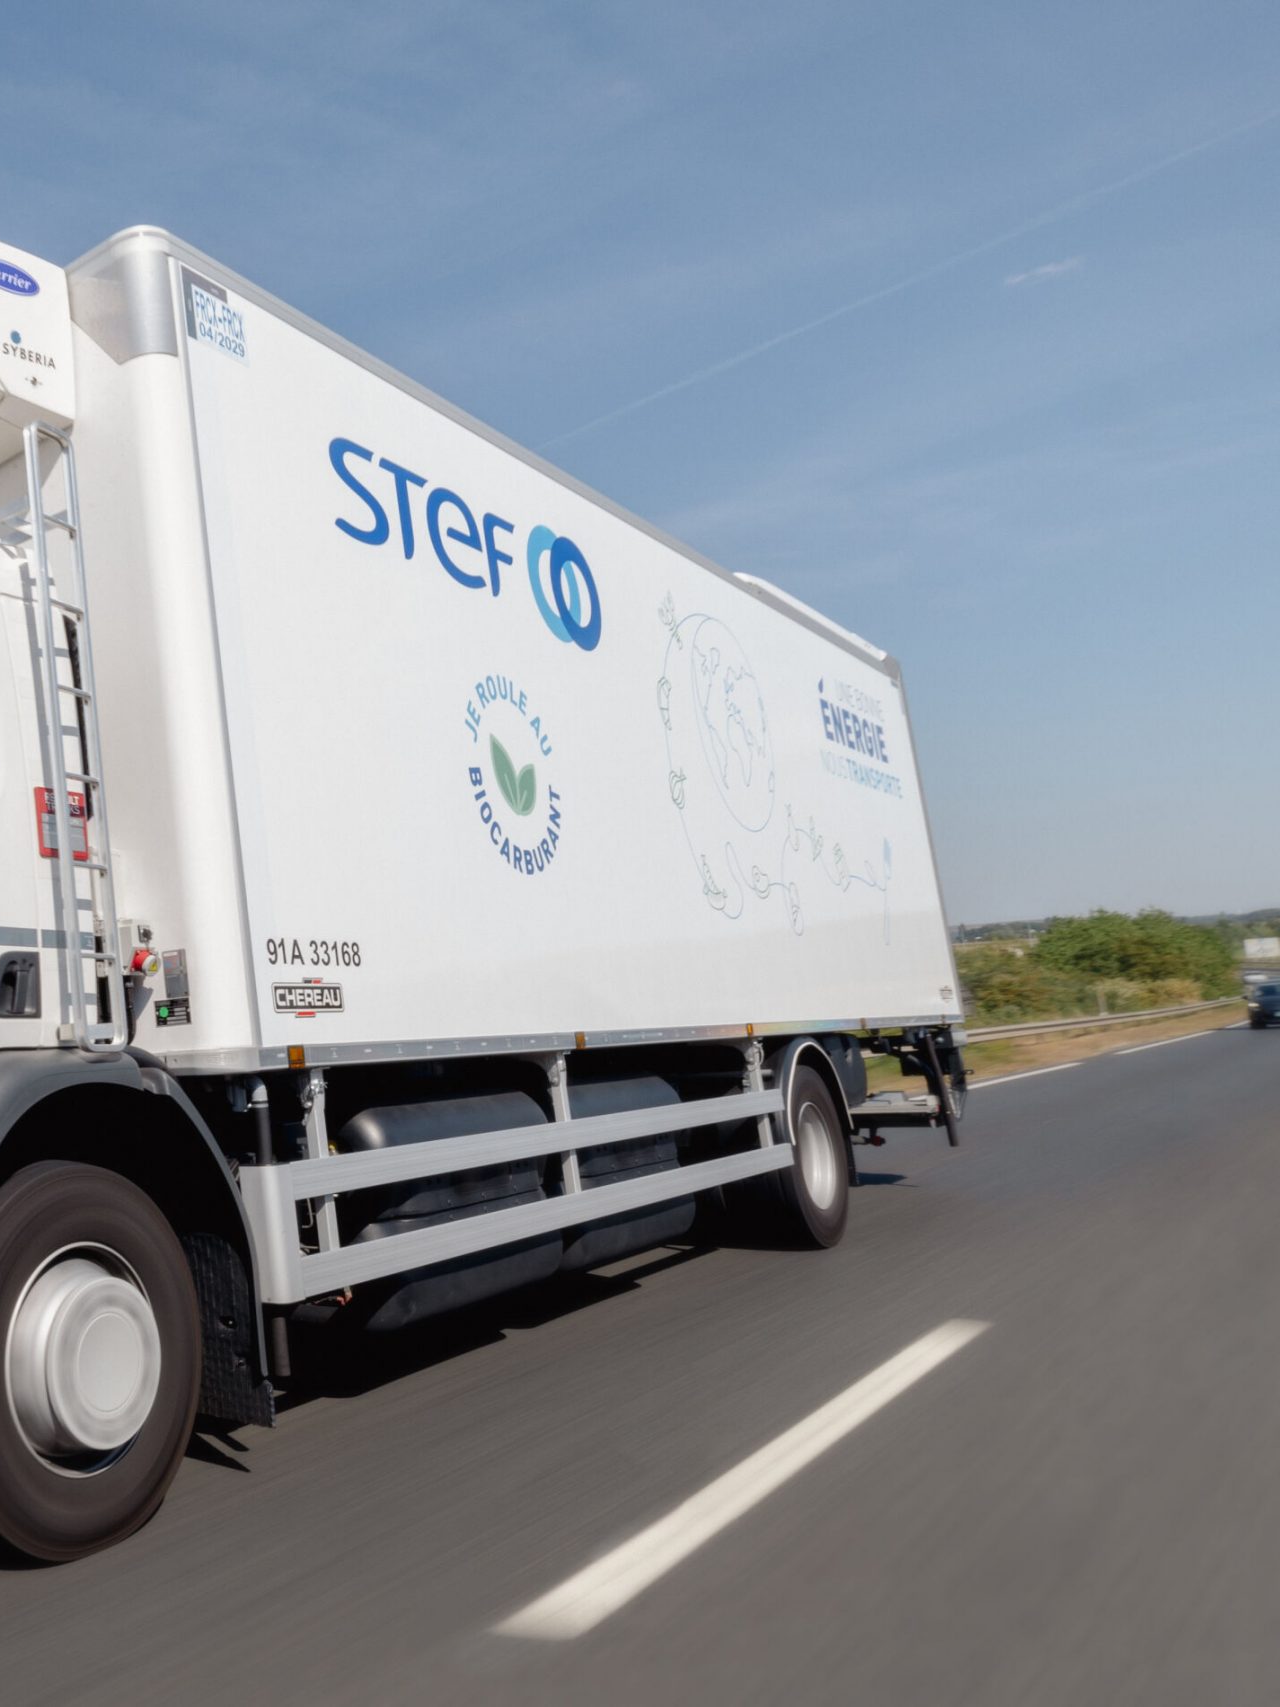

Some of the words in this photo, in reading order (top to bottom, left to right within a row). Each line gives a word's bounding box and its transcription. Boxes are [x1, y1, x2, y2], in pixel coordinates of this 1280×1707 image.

[1, 342, 56, 369] SYBERIA
[198, 324, 246, 358] 04/2029
[464, 700, 481, 743] JE
[475, 674, 528, 716] ROULE
[529, 716, 552, 757] AU
[469, 766, 561, 876] BIOCARBURANT
[266, 937, 306, 966] 91A
[309, 940, 362, 967] 33168
[275, 988, 342, 1007] CHEREAU
